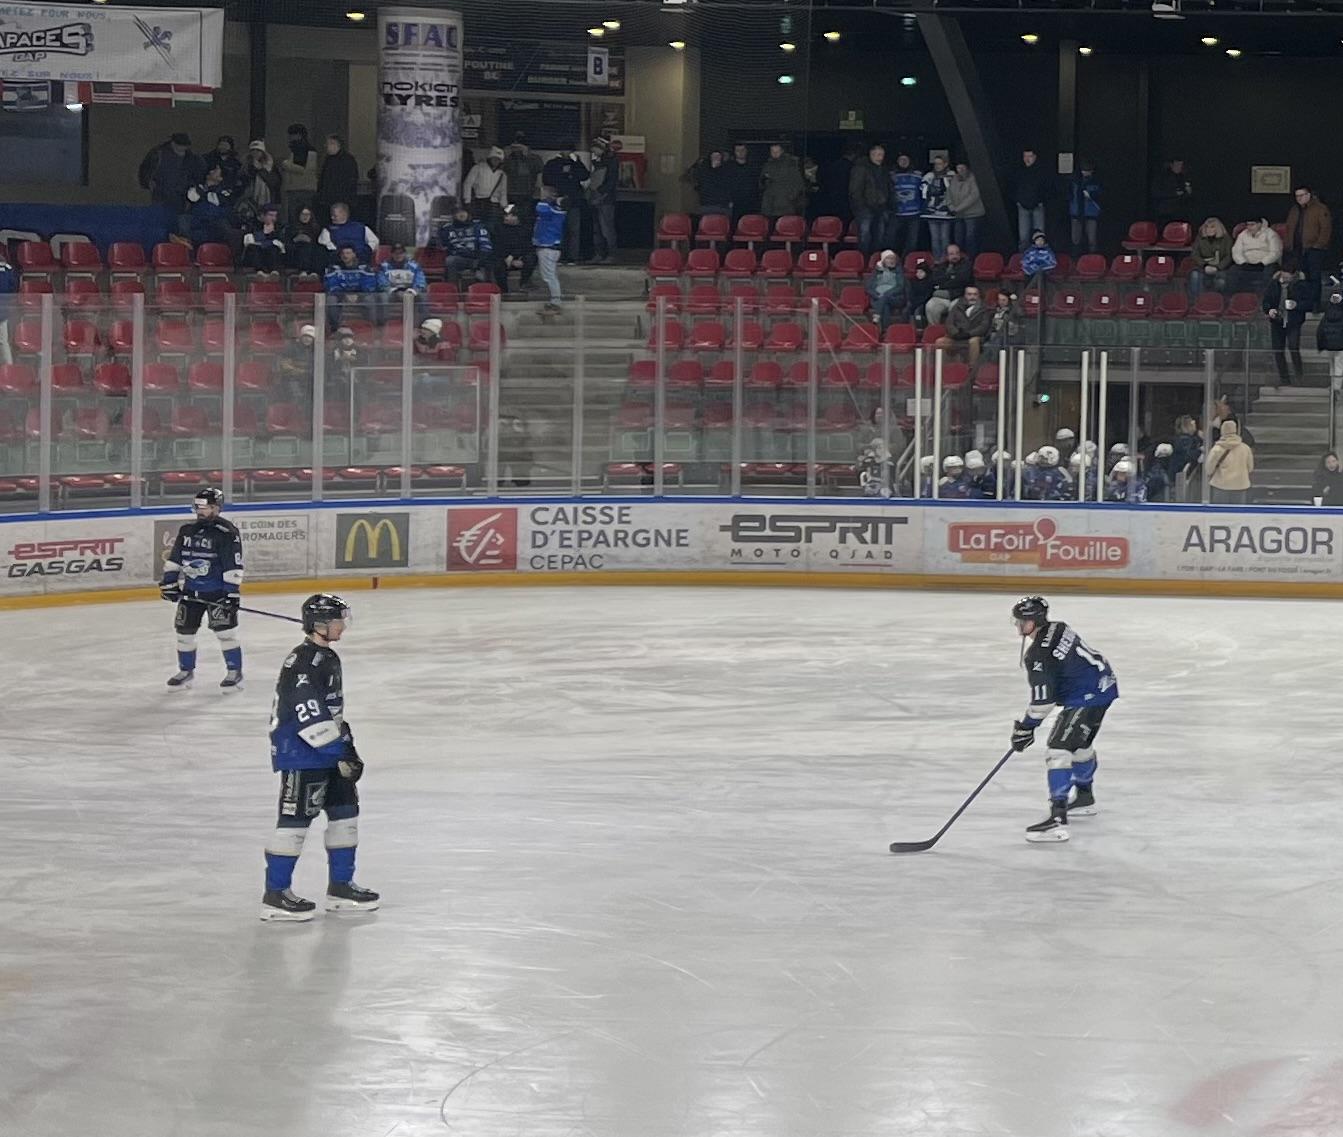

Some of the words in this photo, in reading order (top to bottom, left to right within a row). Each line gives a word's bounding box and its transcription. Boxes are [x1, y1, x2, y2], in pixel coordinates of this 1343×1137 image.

[250, 521, 274, 529] COIN
[277, 520, 297, 529] DES
[530, 507, 631, 525] CAISSE
[530, 529, 688, 549] D'EPARGNE
[959, 530, 985, 549] La
[1182, 525, 1334, 555] ARAGOR
[731, 548, 800, 559] MOTO
[830, 549, 893, 560] QUAD
[1046, 541, 1121, 561] Fouille
[8, 557, 124, 577] GASGAS
[530, 554, 604, 570] CEPAC
[295, 698, 319, 722] 29
